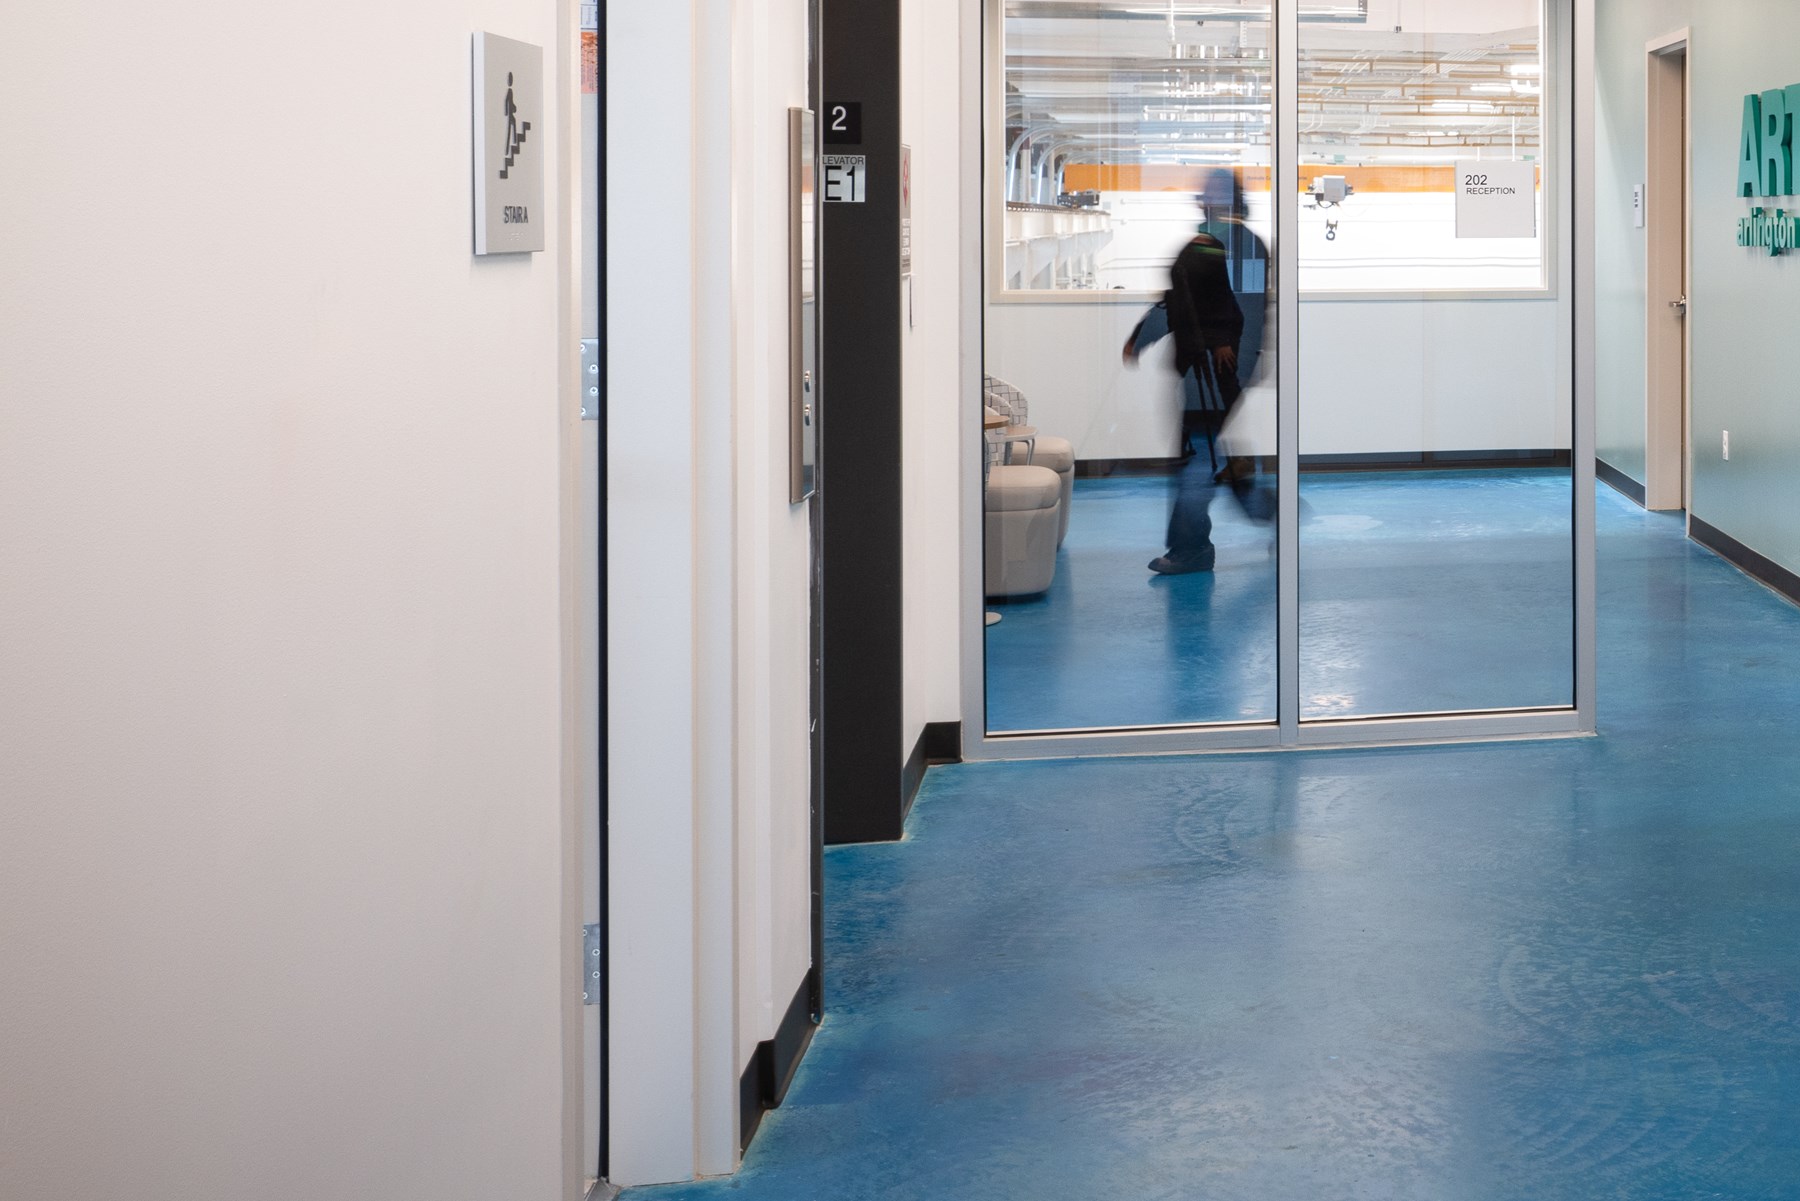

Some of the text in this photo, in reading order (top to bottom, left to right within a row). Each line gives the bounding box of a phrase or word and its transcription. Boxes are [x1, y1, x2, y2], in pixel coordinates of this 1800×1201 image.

[831, 105, 847, 130] 2
[822, 156, 864, 165] LEVATOR
[825, 166, 855, 201] E1
[1465, 175, 1487, 185] 202
[504, 206, 523, 224] STAIR
[1737, 207, 1799, 257] arlington
